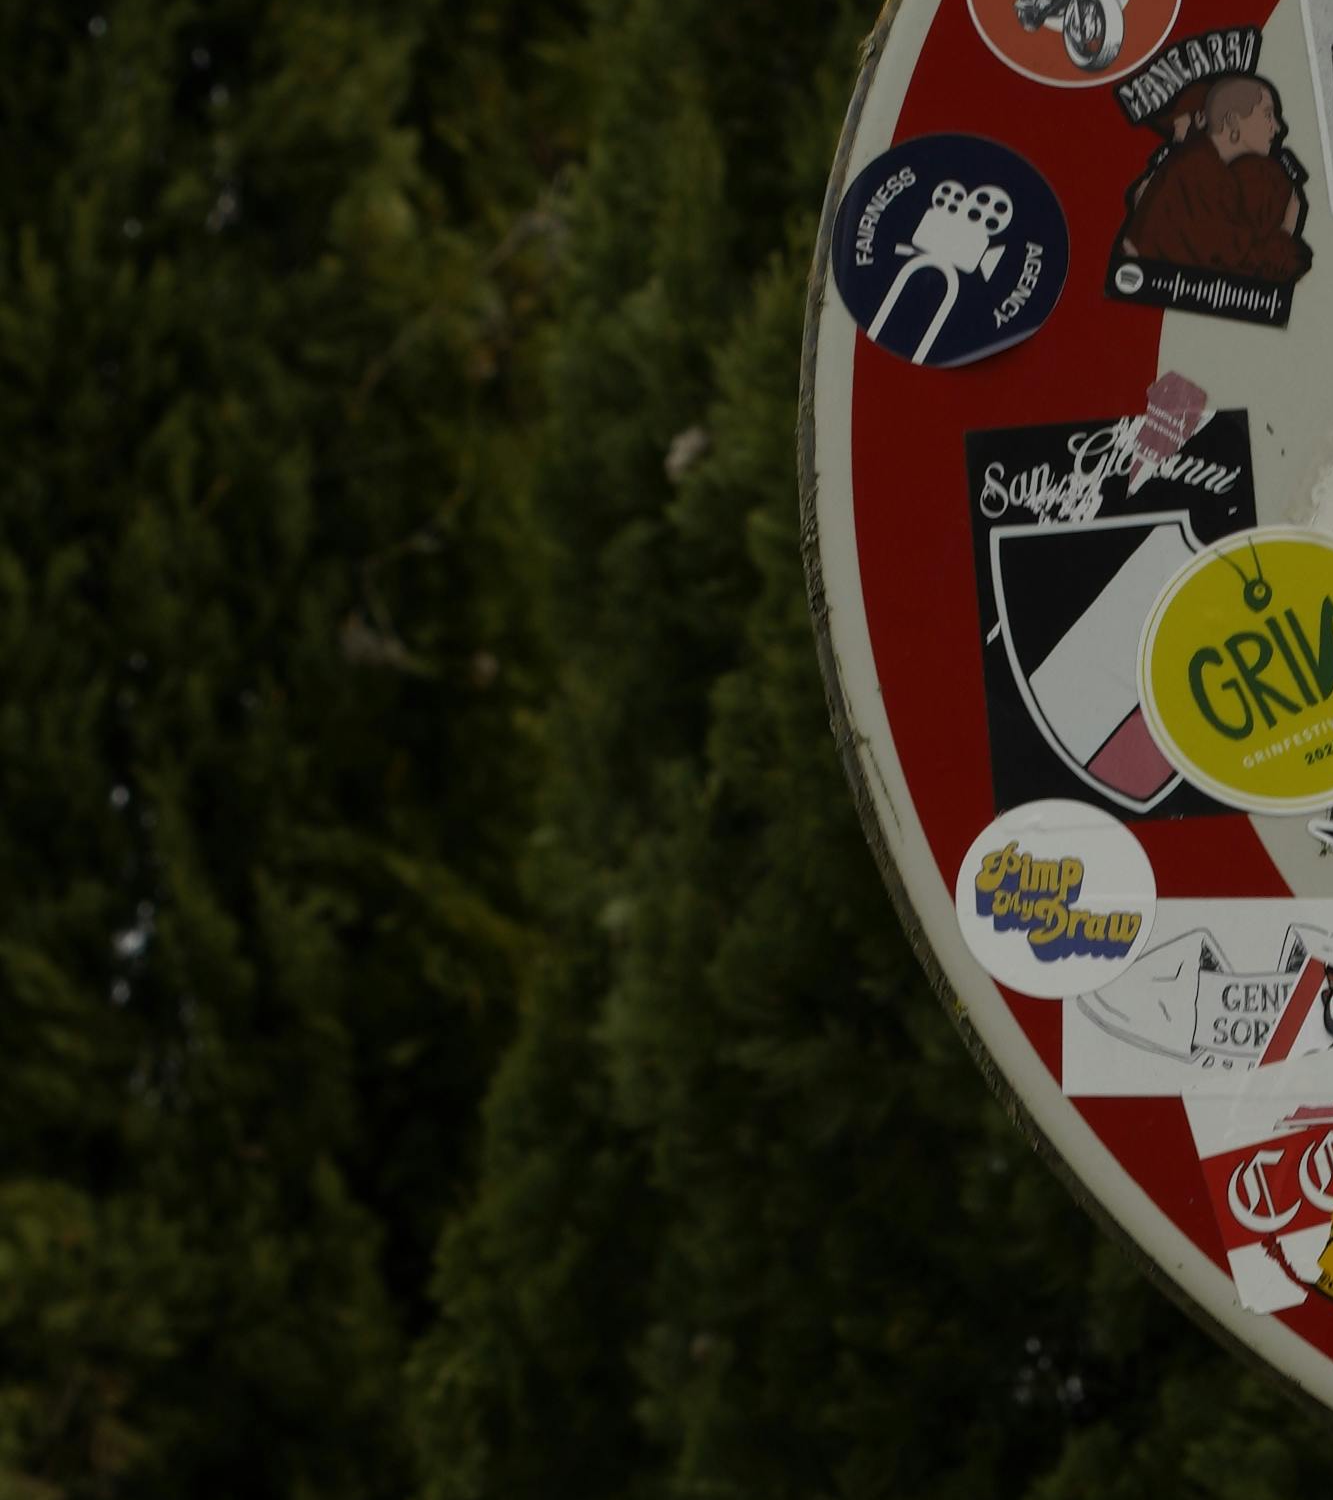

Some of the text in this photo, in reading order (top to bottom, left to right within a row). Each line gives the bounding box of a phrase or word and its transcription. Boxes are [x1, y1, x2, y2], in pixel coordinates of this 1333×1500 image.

[855, 165, 917, 267] FAIRNESS
[993, 241, 1044, 329] AGENCY
[979, 461, 1055, 520] San
[976, 840, 1085, 899] Pimp
[1028, 898, 1142, 949] Draw
